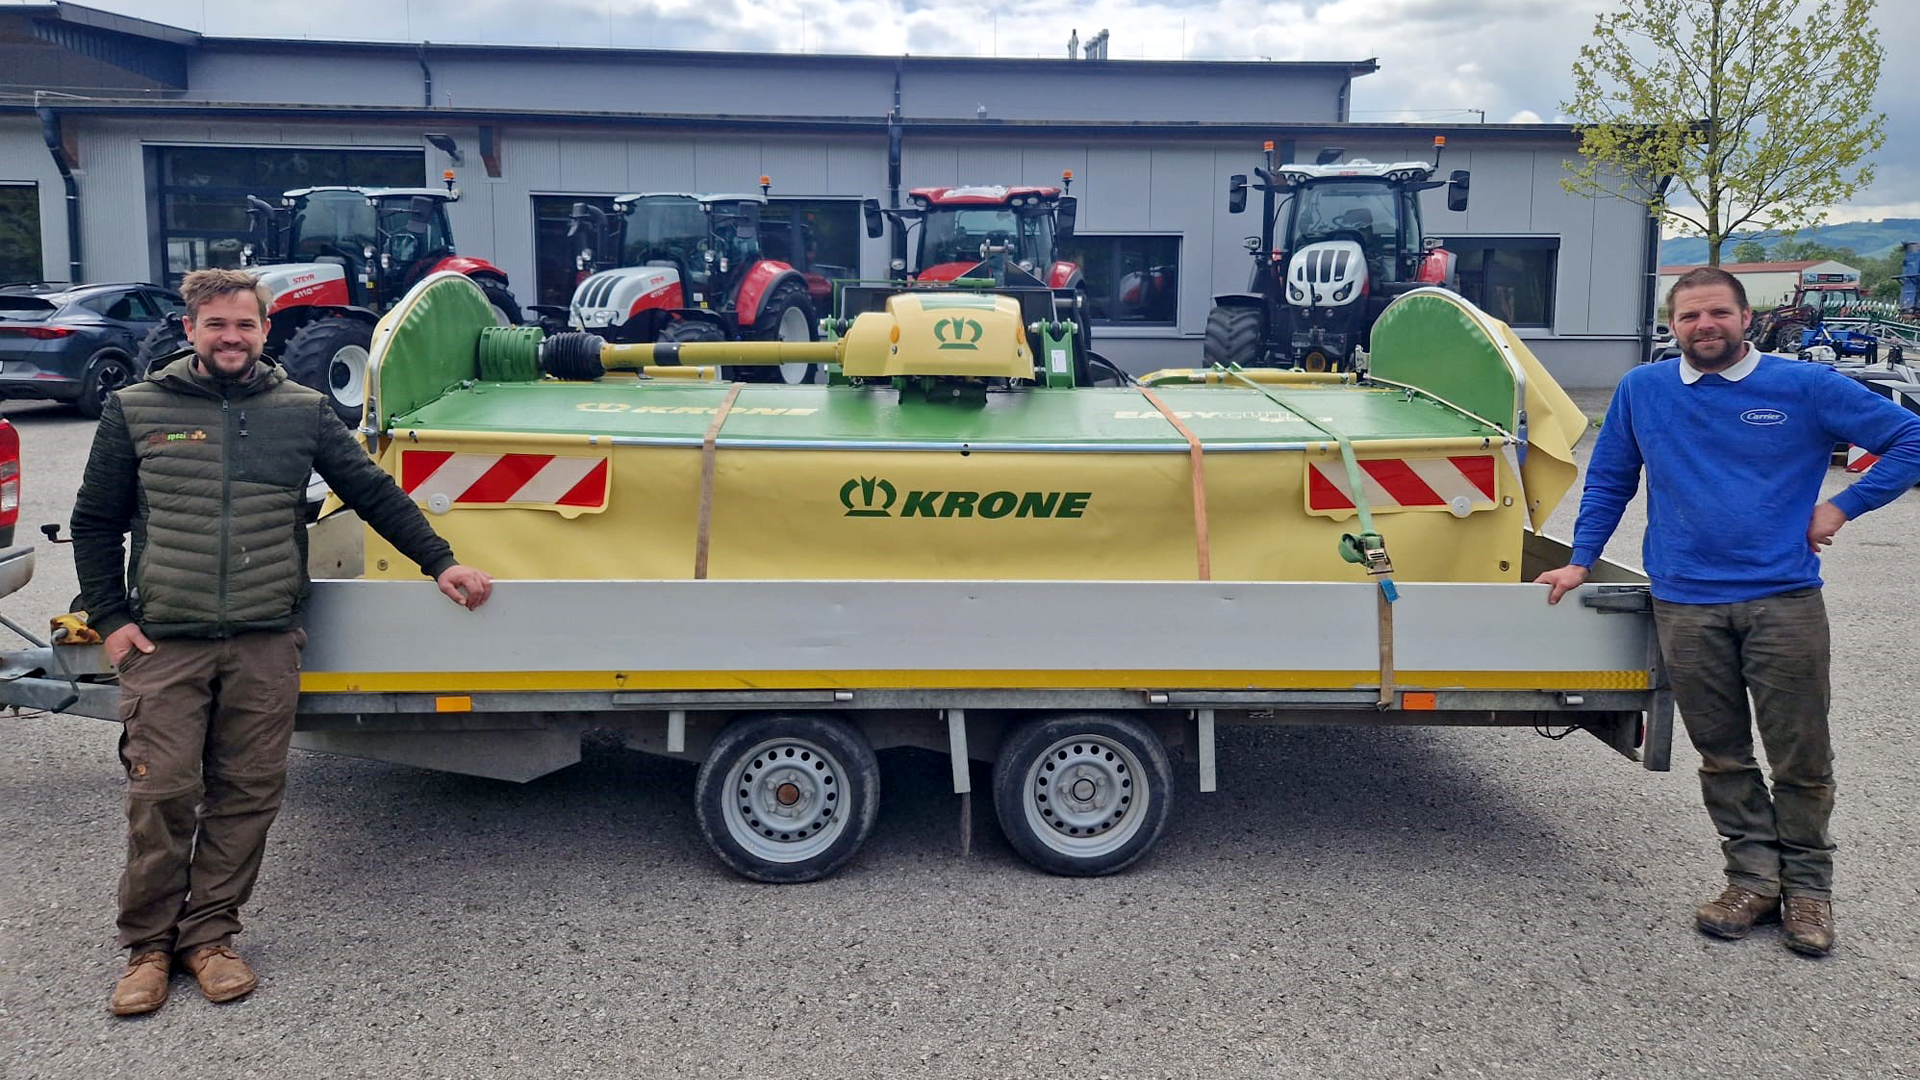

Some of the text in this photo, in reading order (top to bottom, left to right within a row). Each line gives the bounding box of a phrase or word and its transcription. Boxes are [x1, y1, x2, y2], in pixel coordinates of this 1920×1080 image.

[293, 274, 315, 284] STEYR
[631, 406, 818, 416] KRONE
[1746, 412, 1781, 420] Carrier
[900, 491, 1092, 519] KRONE
